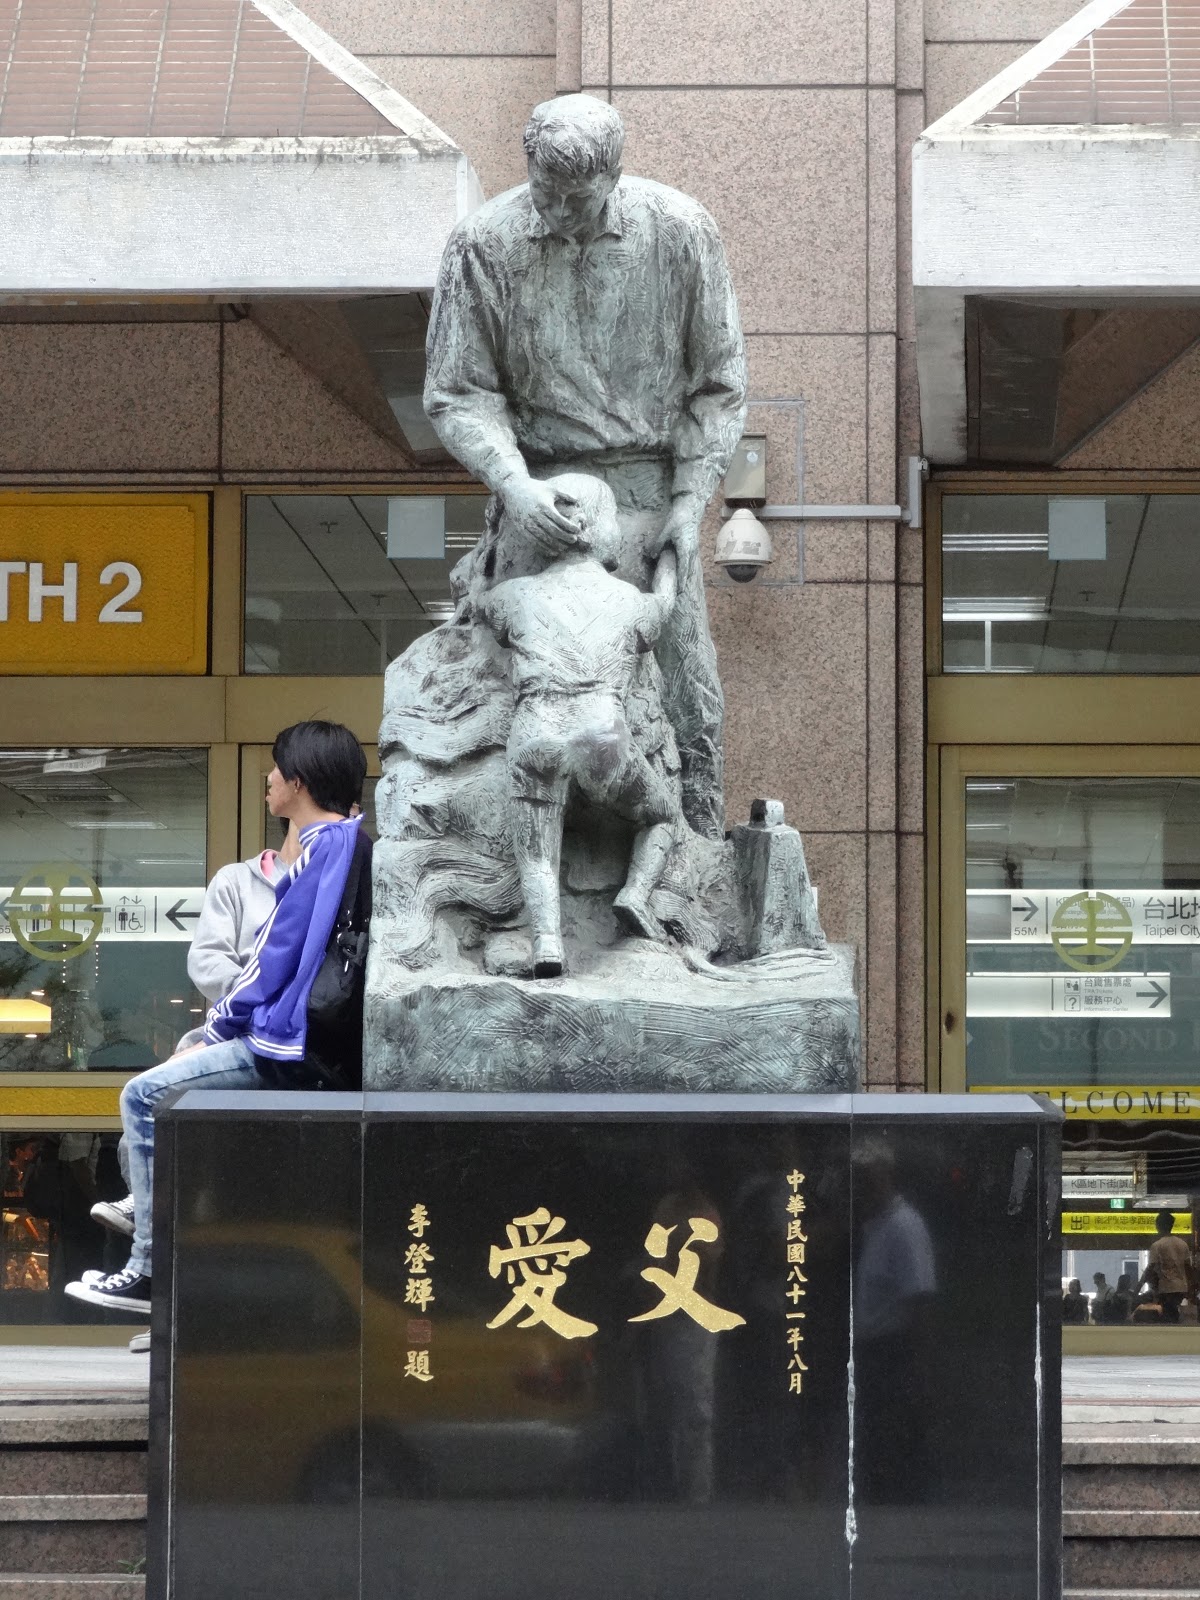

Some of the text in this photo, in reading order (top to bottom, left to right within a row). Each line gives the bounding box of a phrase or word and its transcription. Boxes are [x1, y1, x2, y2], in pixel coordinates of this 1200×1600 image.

[0, 561, 143, 623] TH 2
[1014, 926, 1038, 936] 55M
[1142, 924, 1177, 938] Taipei
[1084, 995, 1122, 1006] 服務中心
[785, 1168, 809, 1395] 中華民國八十一年八月
